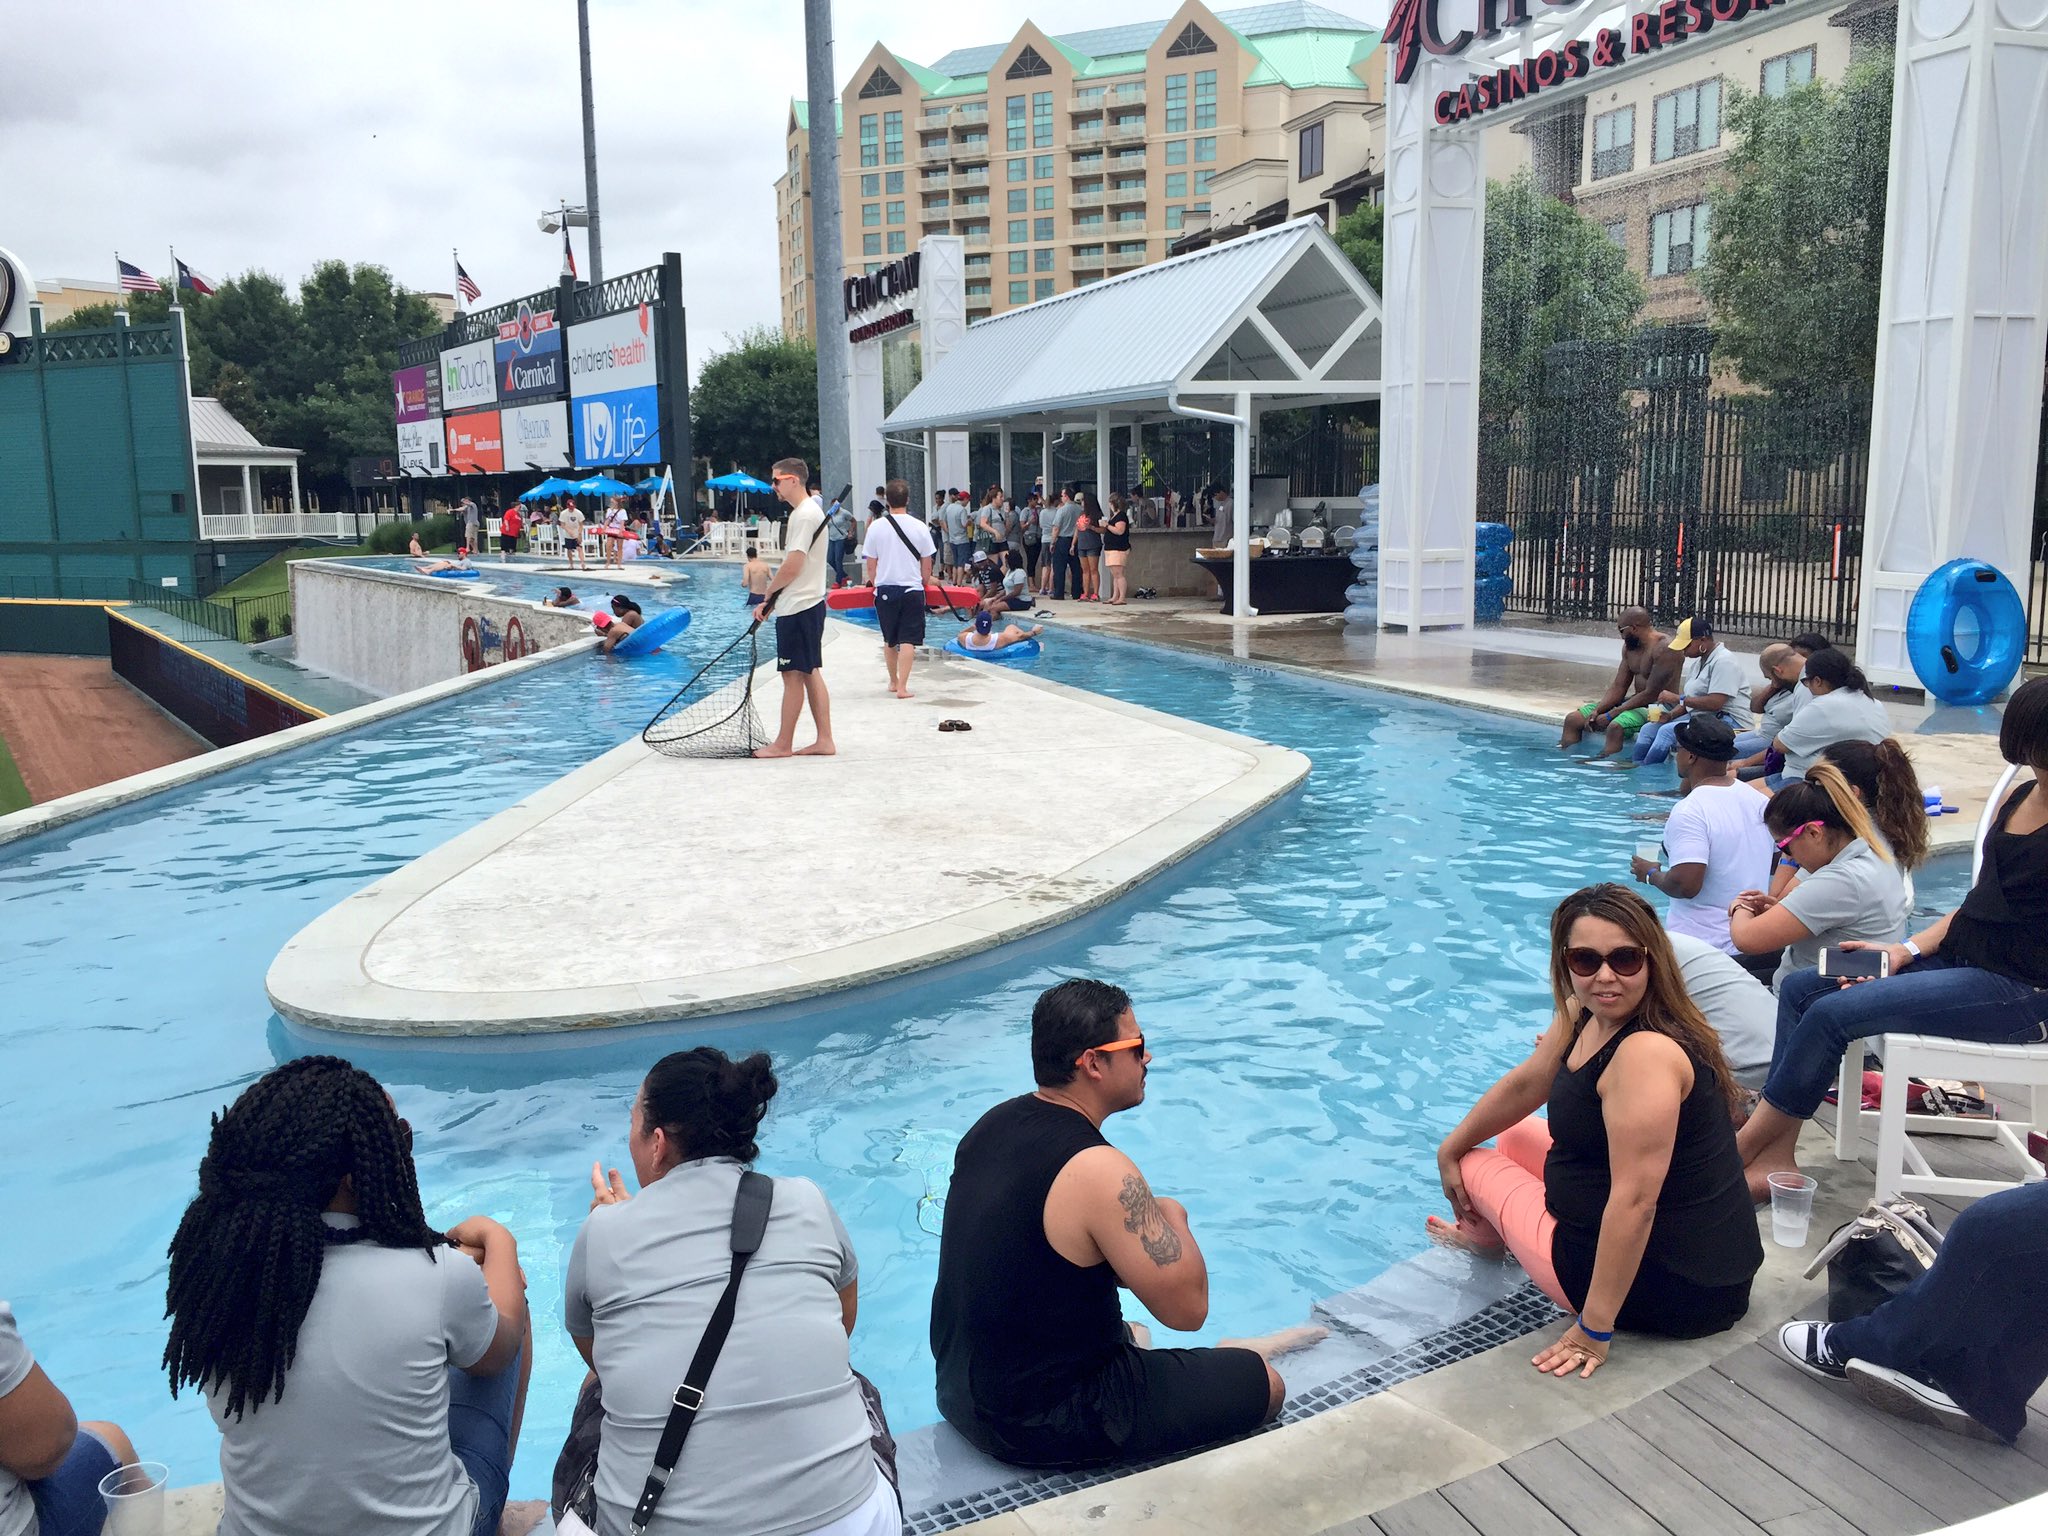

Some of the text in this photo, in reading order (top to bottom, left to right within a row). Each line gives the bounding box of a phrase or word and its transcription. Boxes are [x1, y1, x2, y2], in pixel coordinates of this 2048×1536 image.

[1434, 40, 1588, 125] CASINOS
[1593, 28, 1626, 67] &
[1631, 0, 1779, 54] RESO
[447, 349, 489, 392] InTouch
[514, 358, 556, 390] Carnival
[522, 418, 552, 440] BAYLOR
